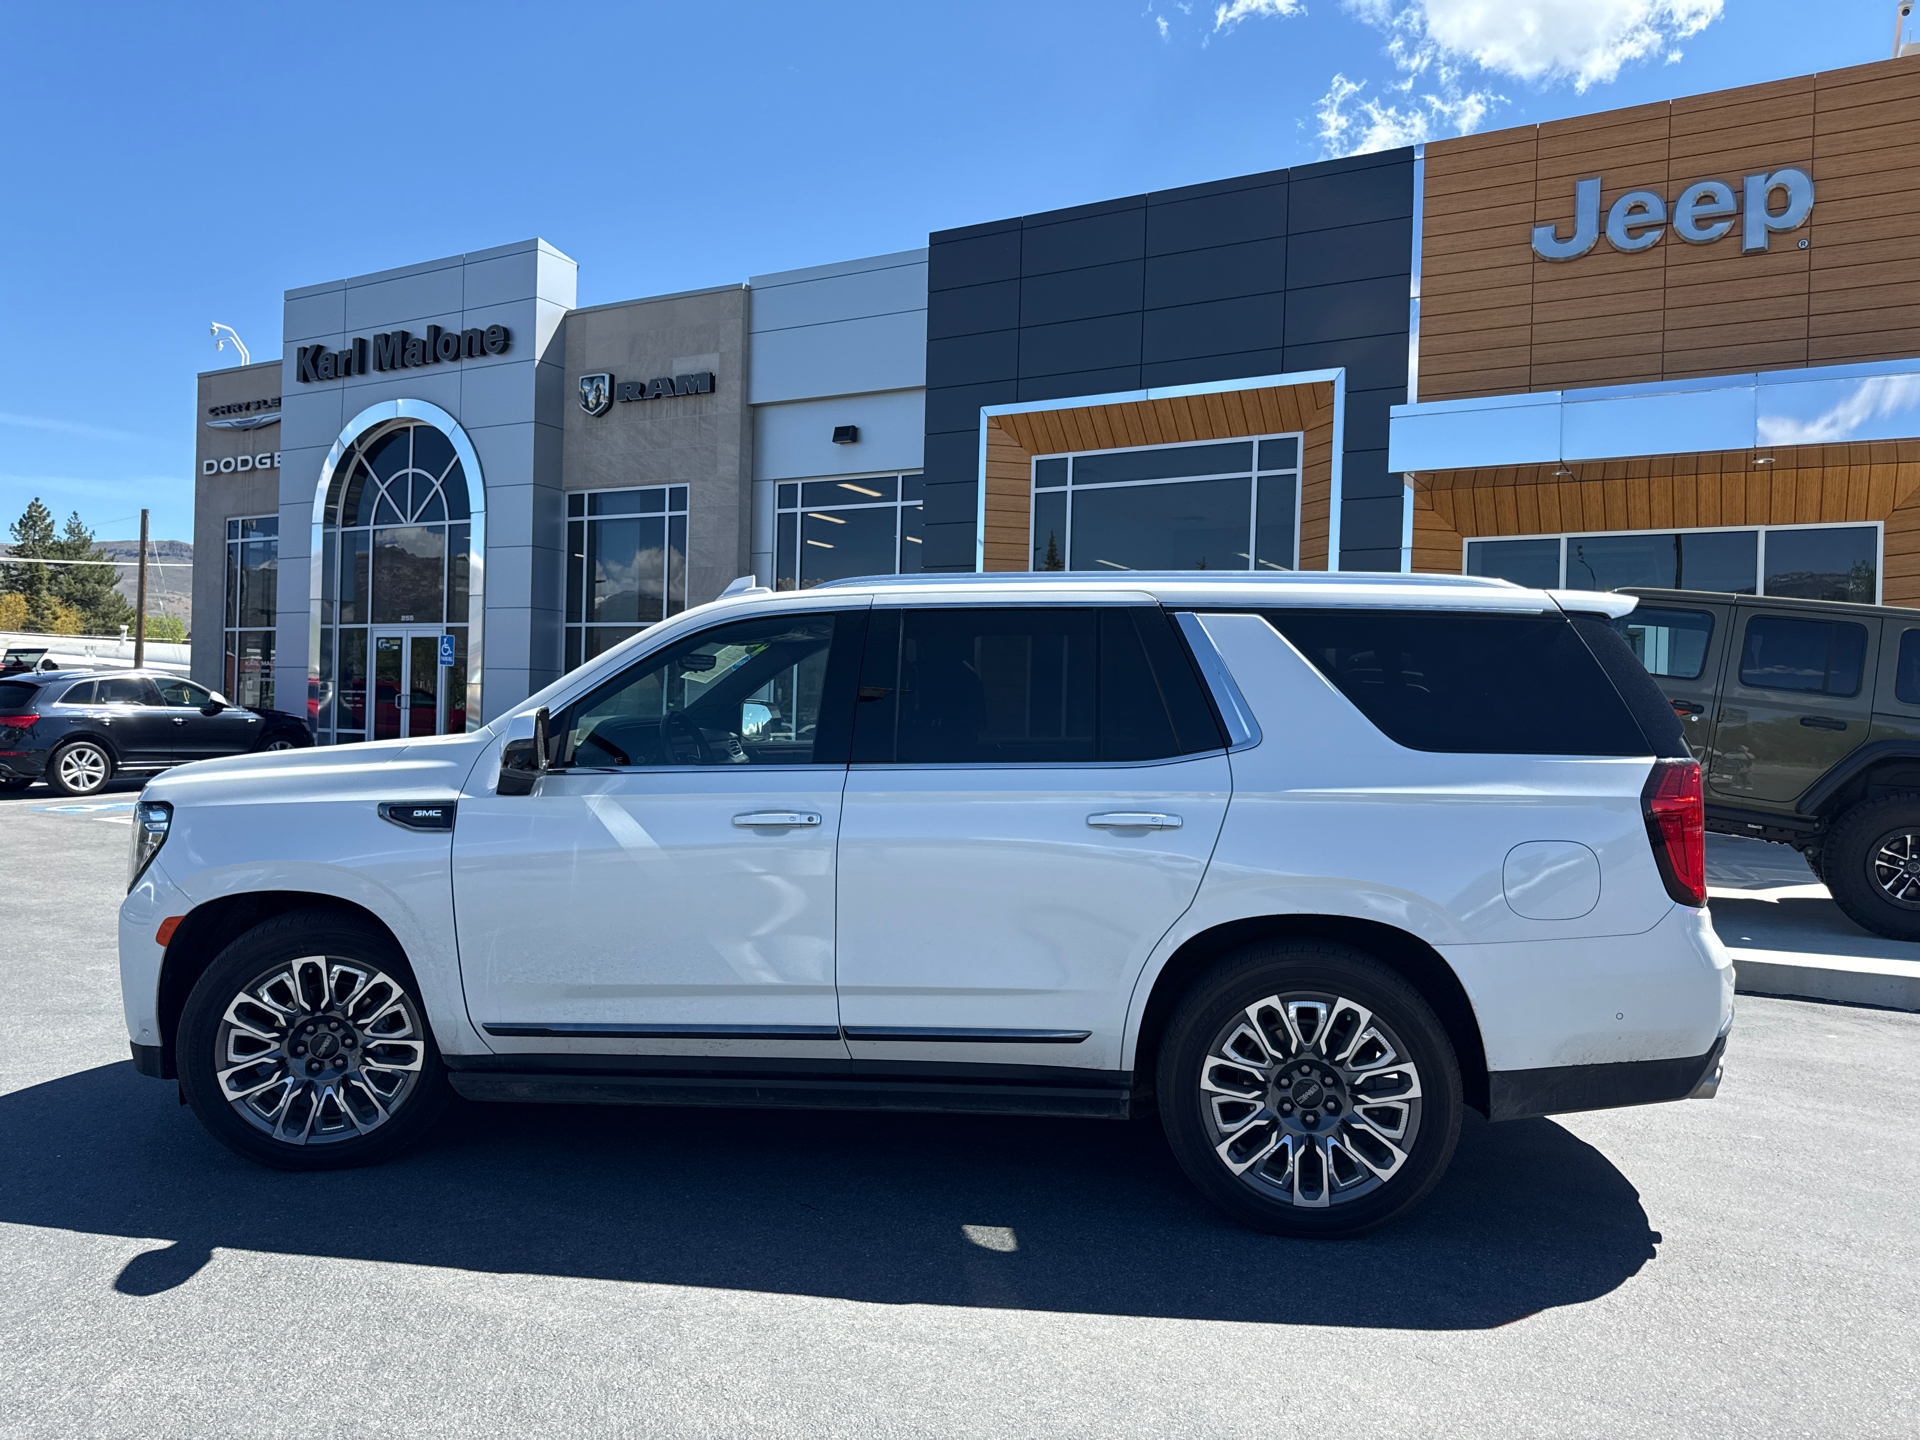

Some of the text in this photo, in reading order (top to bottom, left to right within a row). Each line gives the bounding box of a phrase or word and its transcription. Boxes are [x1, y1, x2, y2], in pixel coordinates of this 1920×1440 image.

[1531, 167, 1815, 263] Jeep
[296, 323, 511, 384] Karl Malone
[616, 371, 716, 403] RAM
[400, 614, 415, 622] 255
[412, 809, 442, 817] GMC
